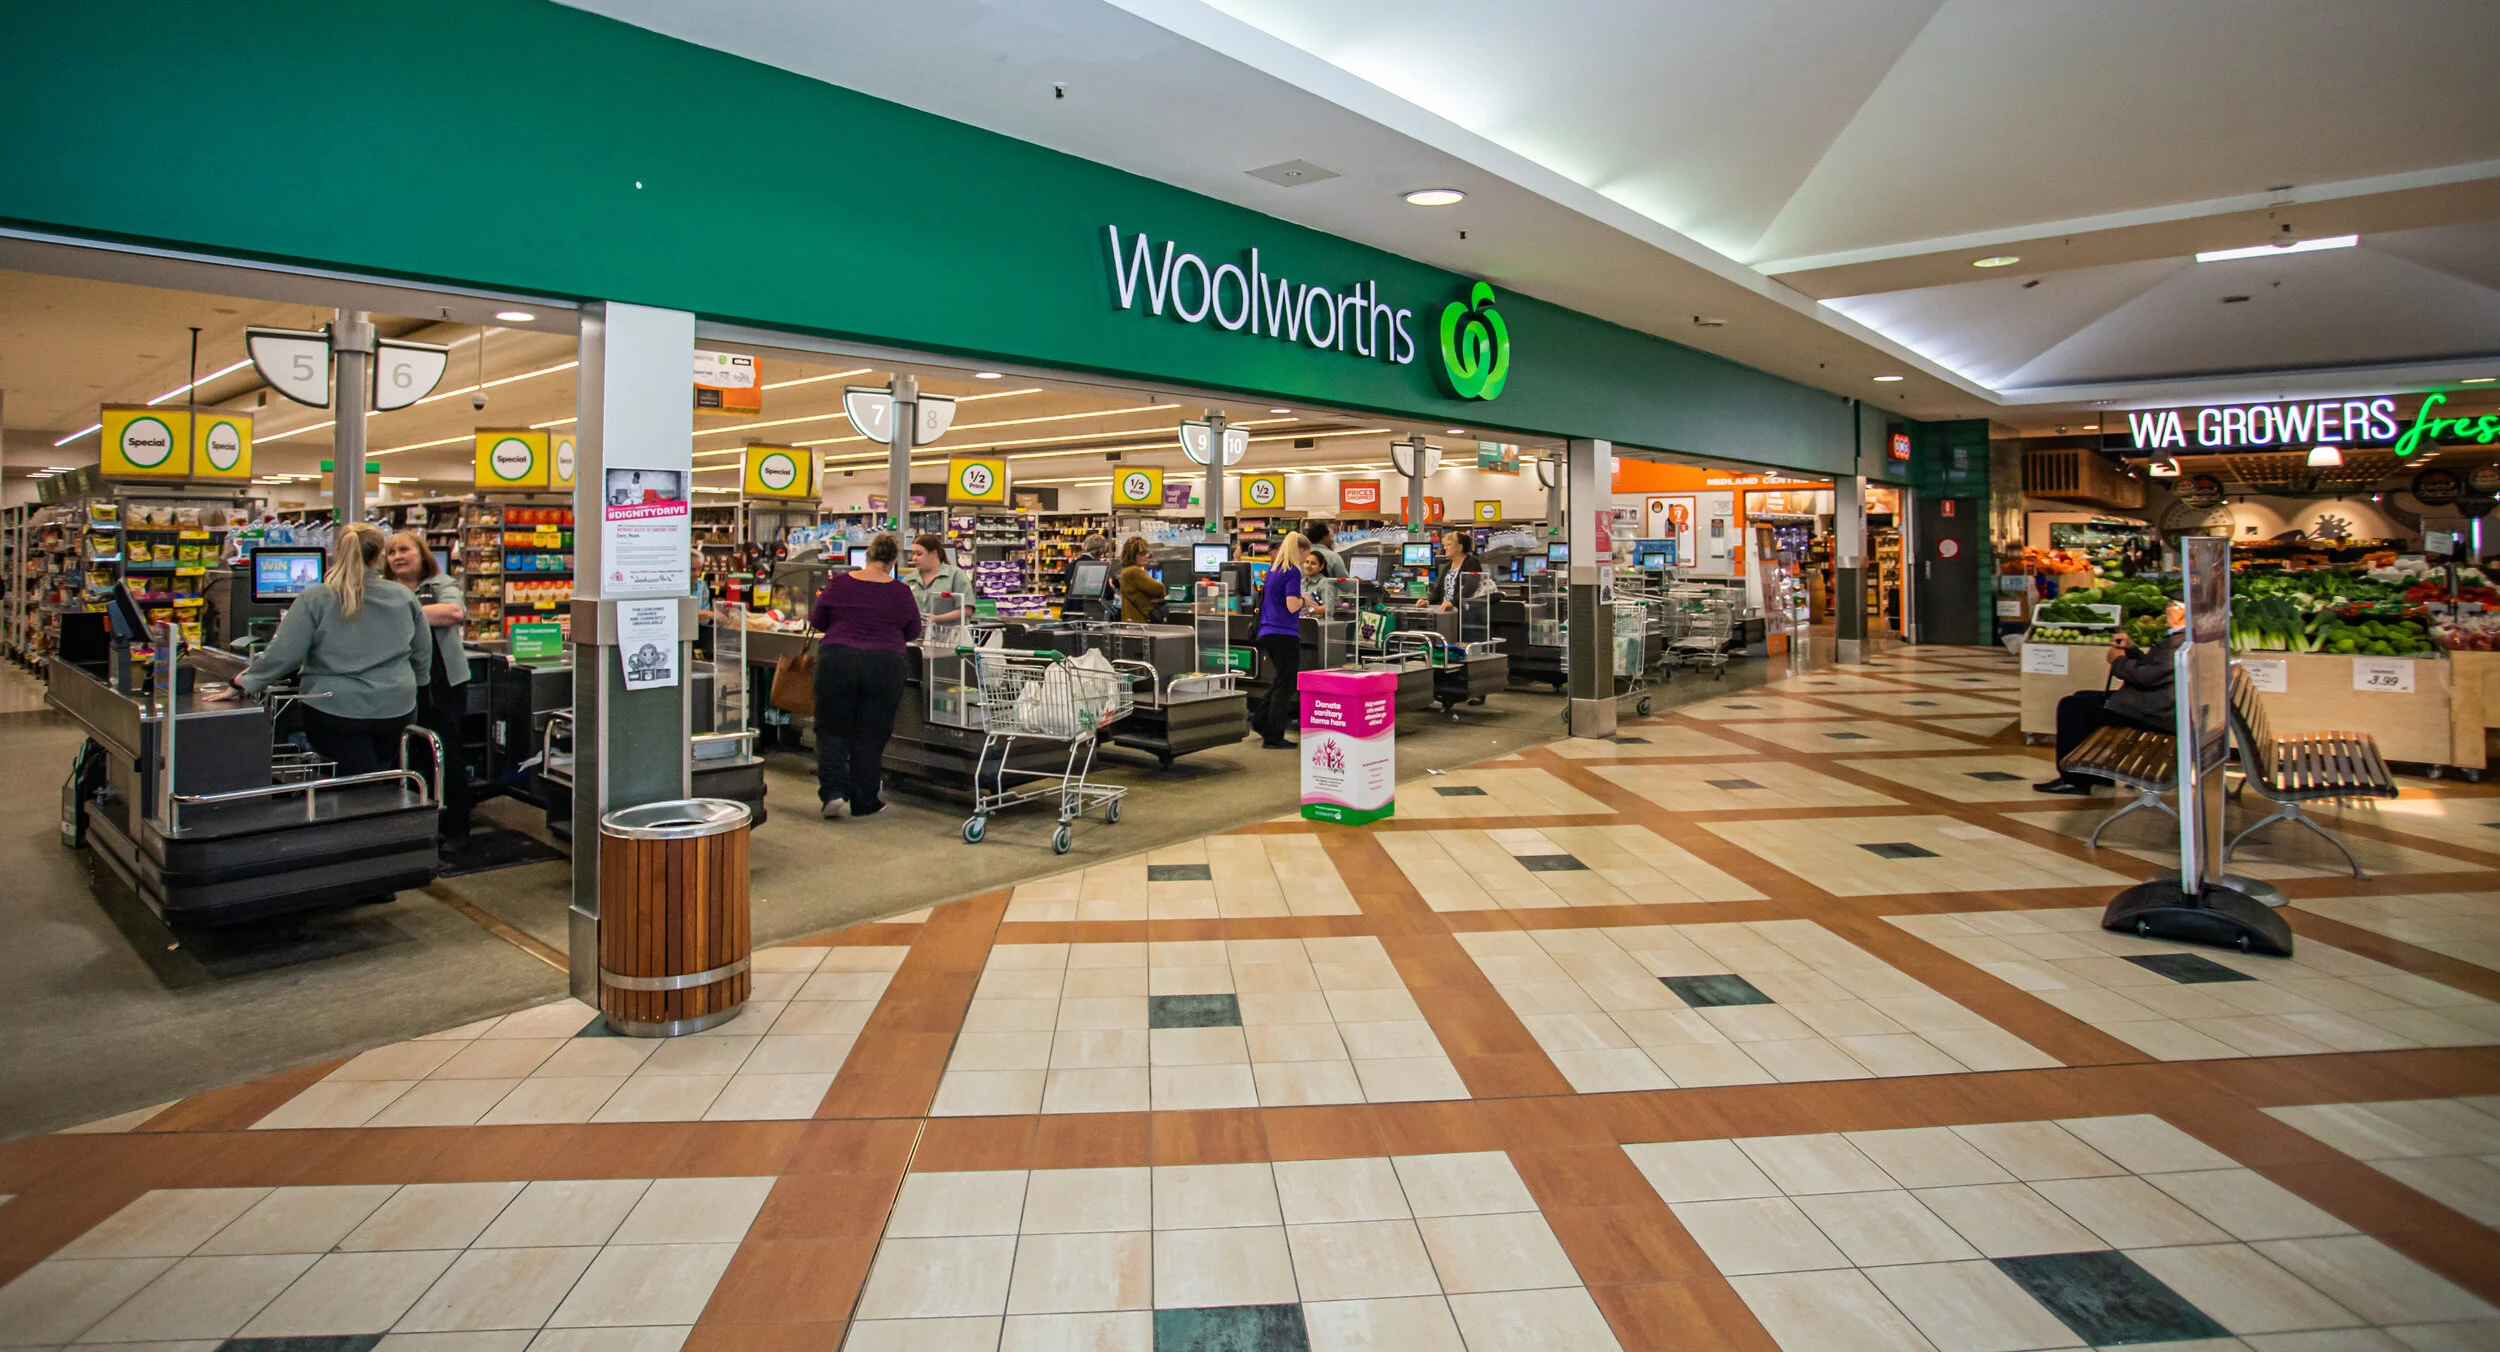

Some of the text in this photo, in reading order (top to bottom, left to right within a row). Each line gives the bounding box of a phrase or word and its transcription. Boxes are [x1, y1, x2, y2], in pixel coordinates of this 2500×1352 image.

[1109, 224, 1414, 365] Woolworths
[292, 354, 314, 381] 5
[392, 363, 413, 389] 6
[871, 404, 885, 425] 7
[927, 410, 937, 429] 8
[2128, 392, 2500, 455] WA GROWERS fres
[128, 438, 165, 448] Special
[212, 441, 236, 452] Special
[1197, 434, 1208, 451] 9
[1228, 438, 1243, 455] 10
[497, 455, 527, 464] Special
[765, 466, 791, 476] Special
[970, 471, 986, 484] 1/2
[1706, 477, 1759, 486] MIDLAND
[1130, 478, 1144, 490] 1/2
[1256, 484, 1269, 495] 1/2
[608, 505, 685, 520] #DIGNITYDRIVE
[261, 560, 287, 571] WIN
[1315, 700, 1341, 710] Donate
[1314, 709, 1342, 720] sanitary
[1310, 716, 1347, 727] items here
